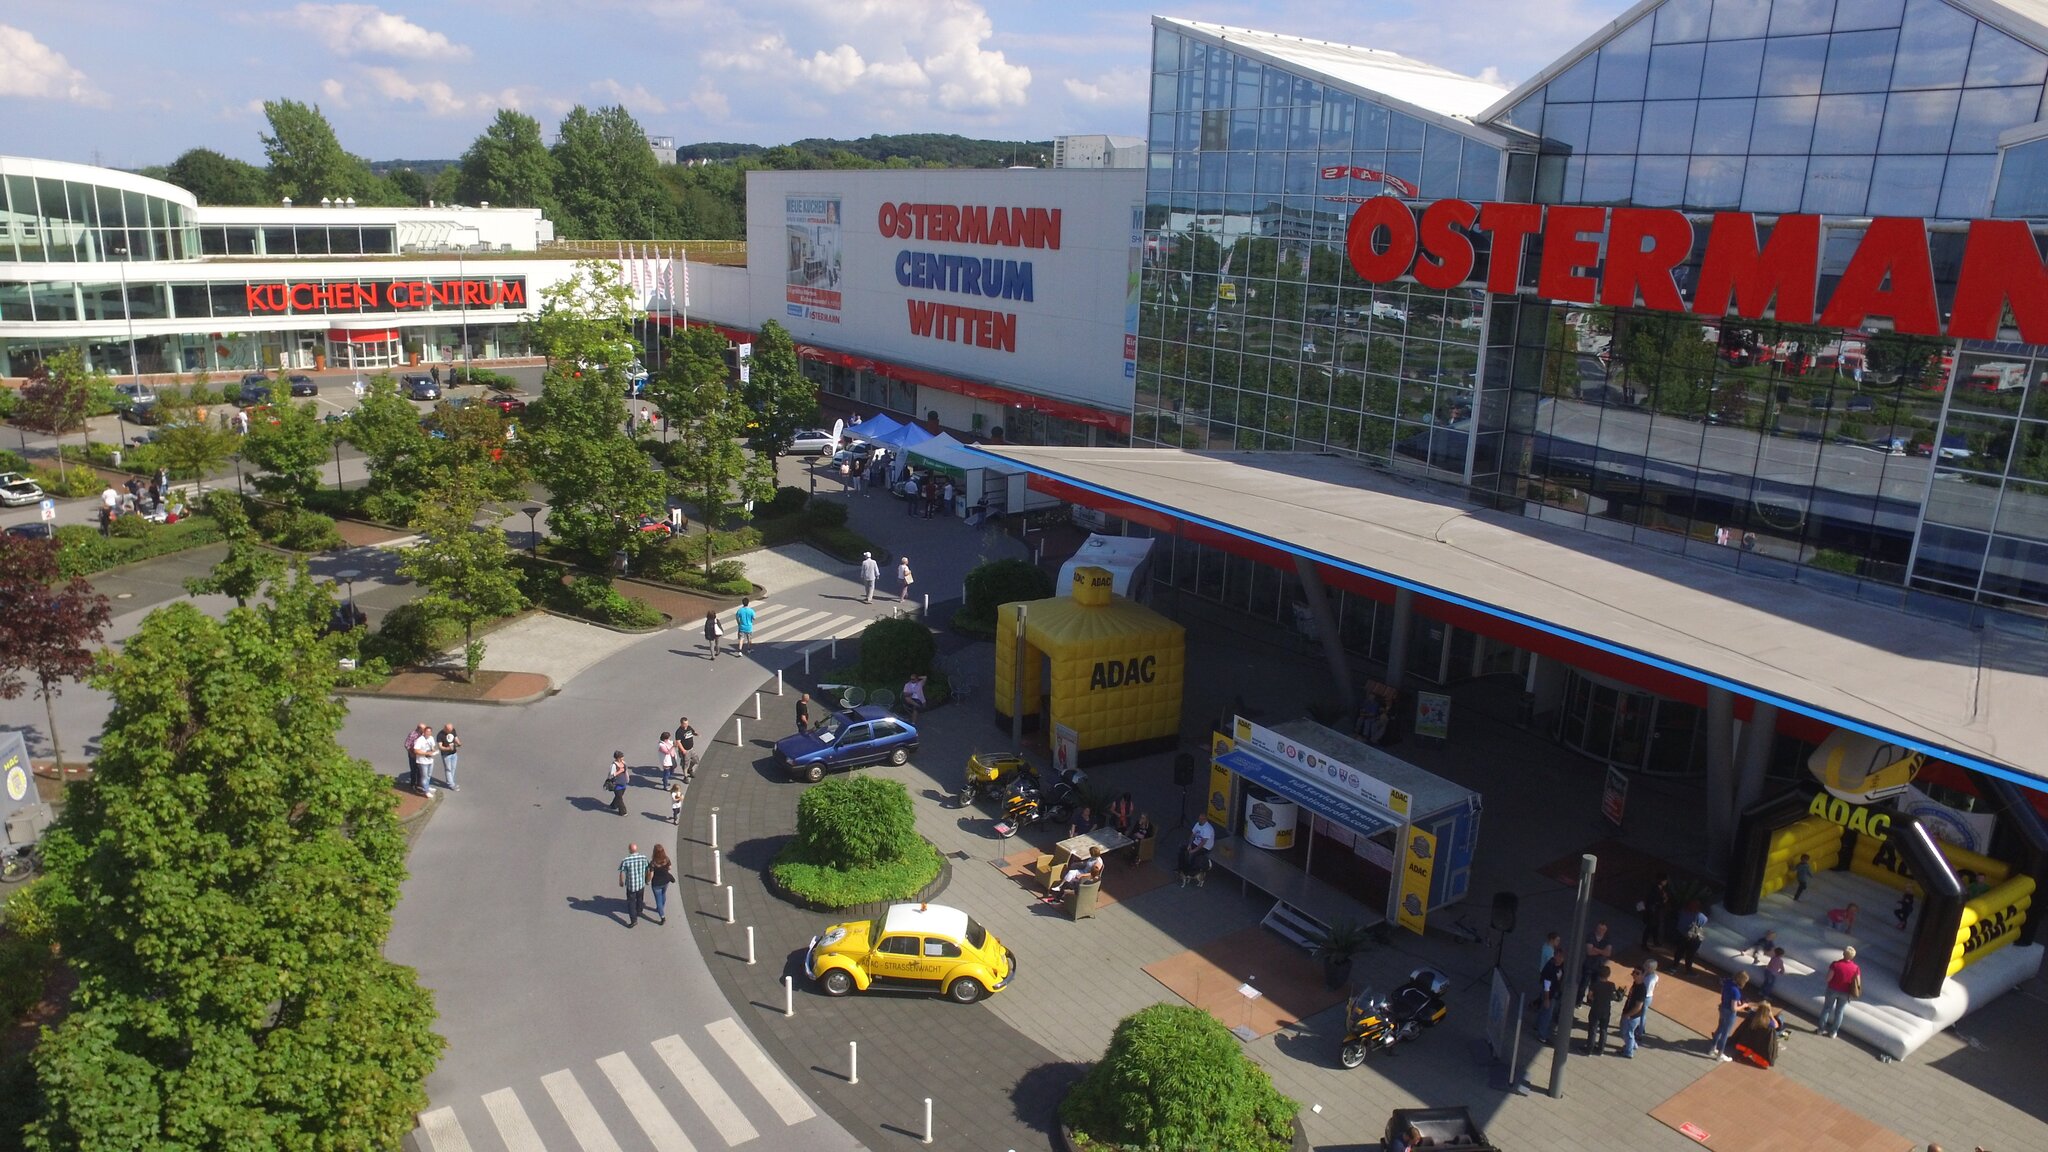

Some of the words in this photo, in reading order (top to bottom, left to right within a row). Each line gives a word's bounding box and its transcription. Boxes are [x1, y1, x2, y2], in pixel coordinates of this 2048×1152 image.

[878, 202, 1062, 250] OSTERMANN
[895, 250, 1034, 303] CENTRUM
[246, 281, 378, 311] KÜCHEN
[386, 280, 524, 308] CENTRUM
[907, 299, 1017, 352] WITTEN
[1090, 577, 1111, 587] ADAC
[1090, 655, 1156, 691] ADAC
[1288, 778, 1305, 790] Full
[1305, 787, 1336, 804] Service
[1349, 806, 1382, 826] Events
[1390, 790, 1408, 803] ADAC
[1809, 791, 1891, 842] ADAC
[1409, 863, 1427, 877] ADAC
[884, 961, 942, 974] STRASSENWACHT
